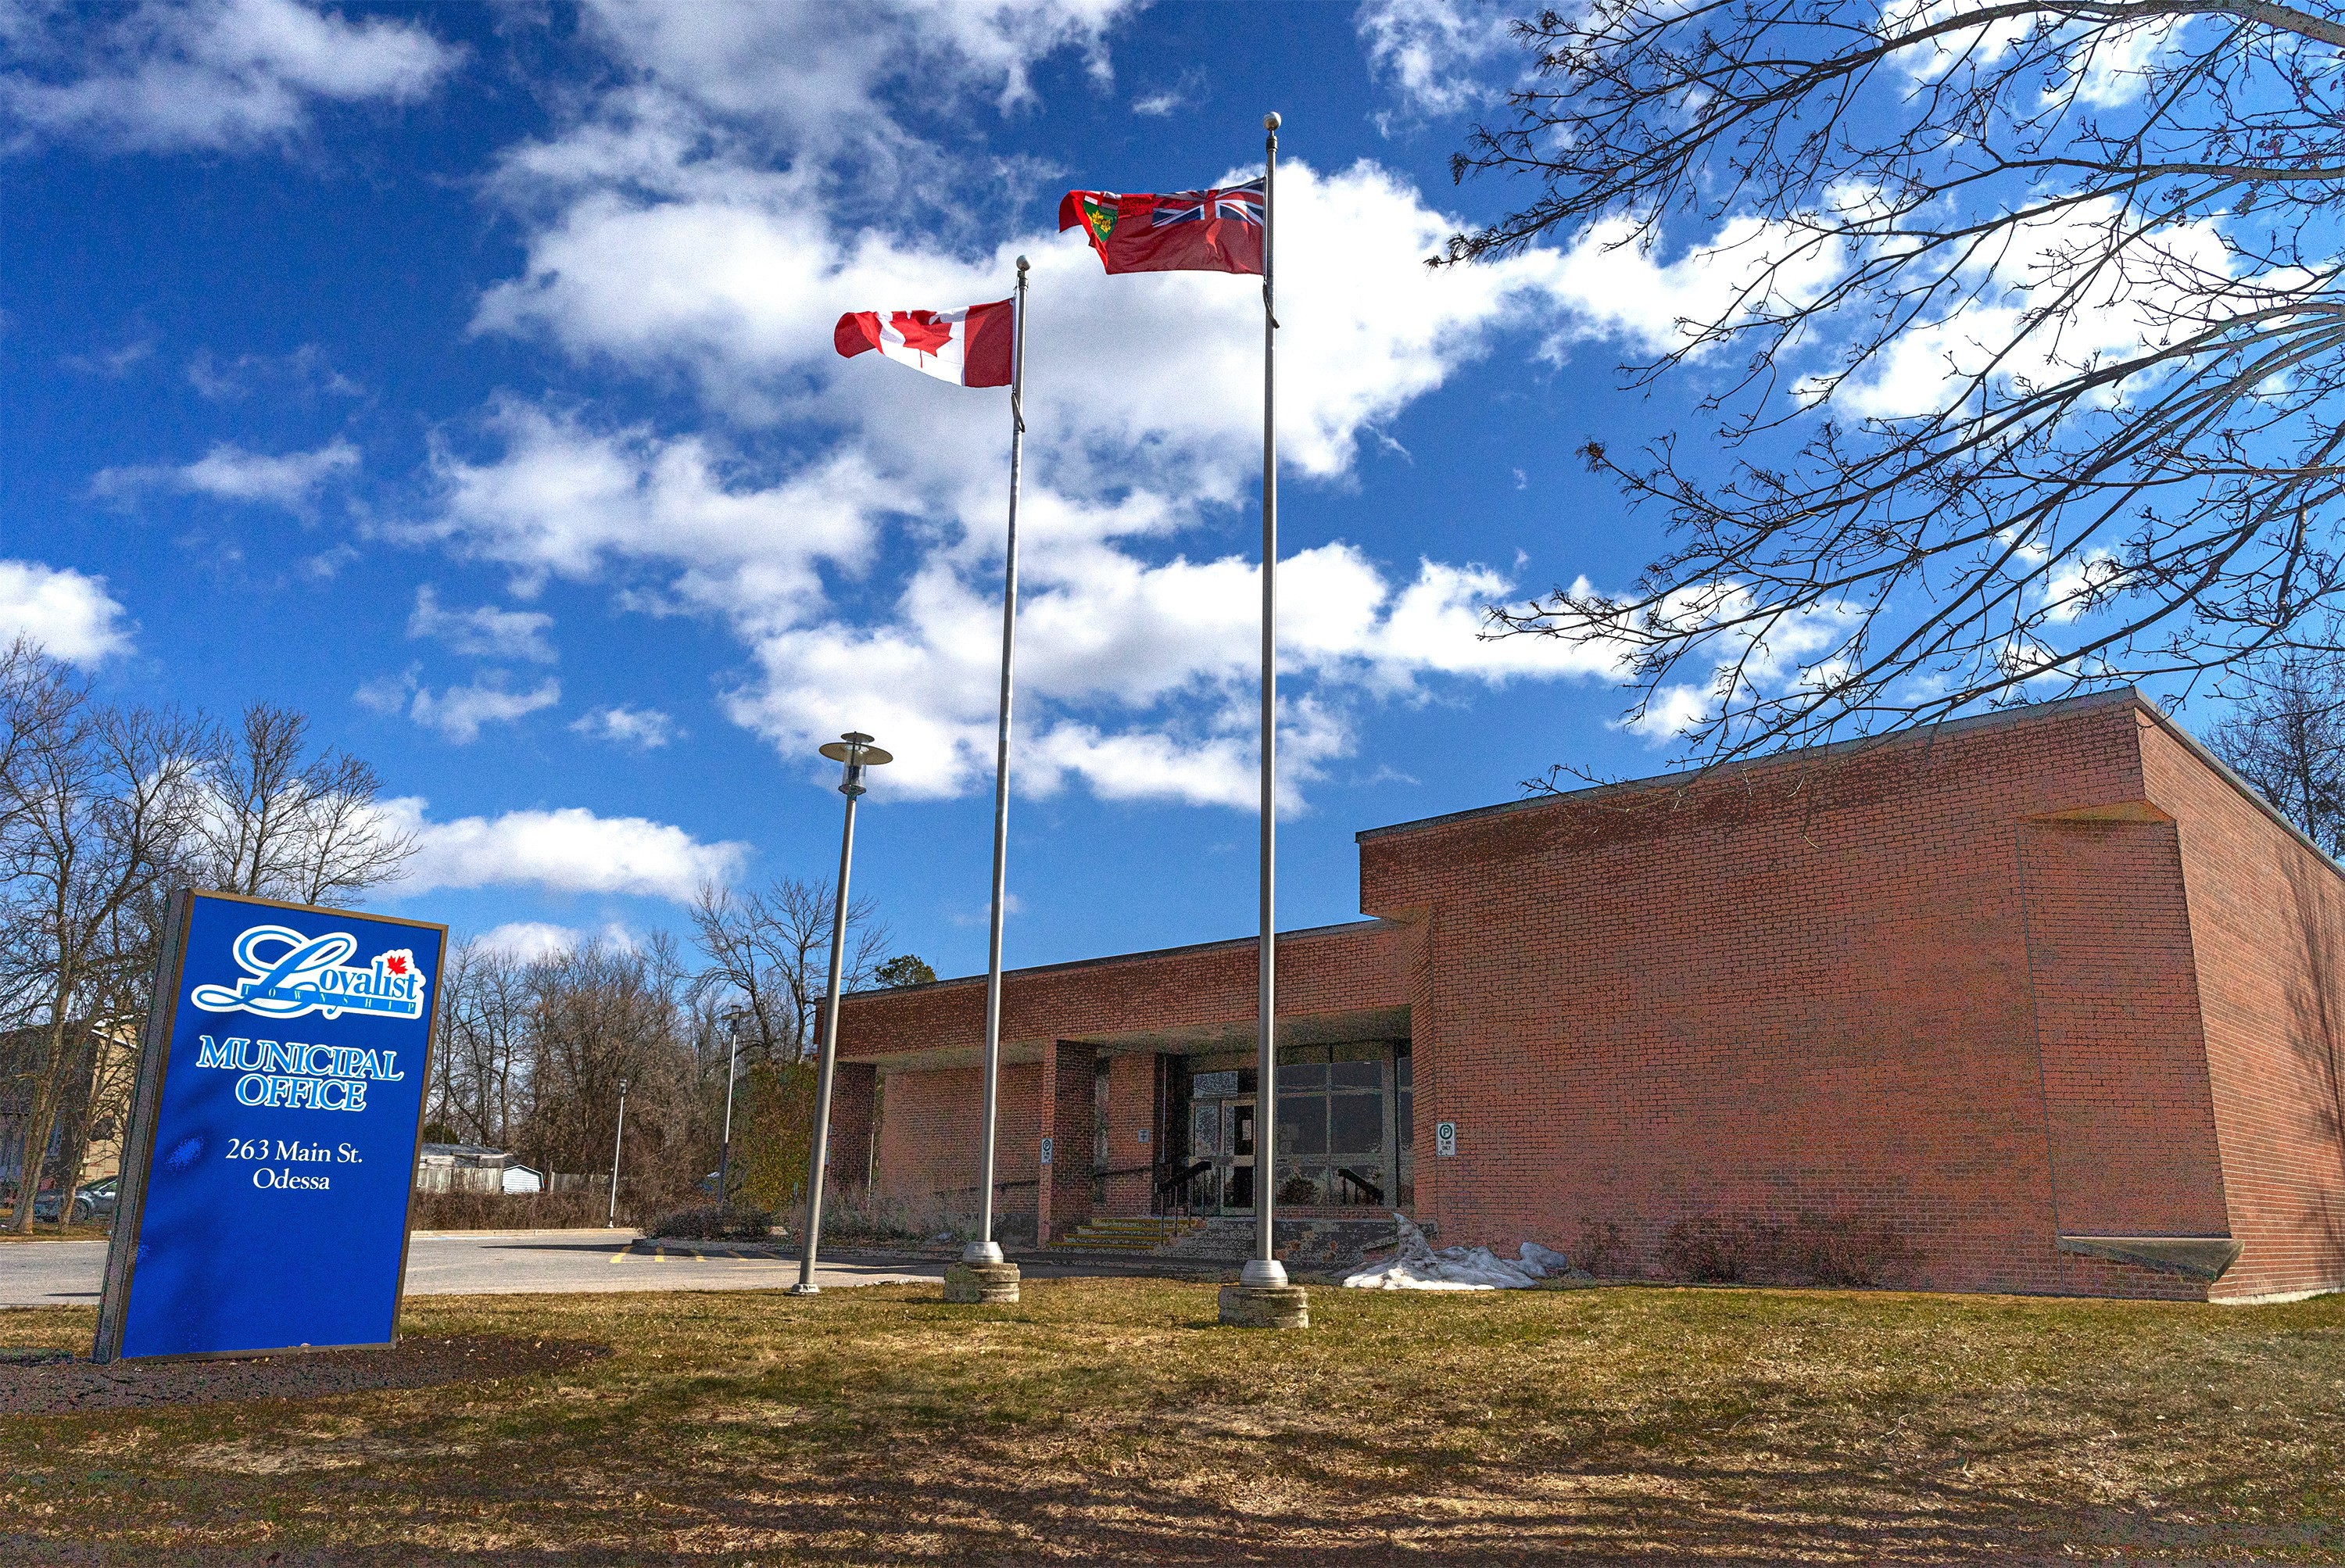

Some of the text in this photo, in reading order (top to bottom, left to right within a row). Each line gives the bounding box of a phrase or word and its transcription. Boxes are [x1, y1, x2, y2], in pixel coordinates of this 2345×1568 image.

[195, 928, 420, 1016] Loyalist
[243, 984, 415, 1012] TOWNSHIP
[196, 1036, 404, 1081] MUNICIPAL
[235, 1073, 367, 1112] OFFICE
[225, 1138, 363, 1163] 263 Main St.
[252, 1168, 330, 1190] Odessa
